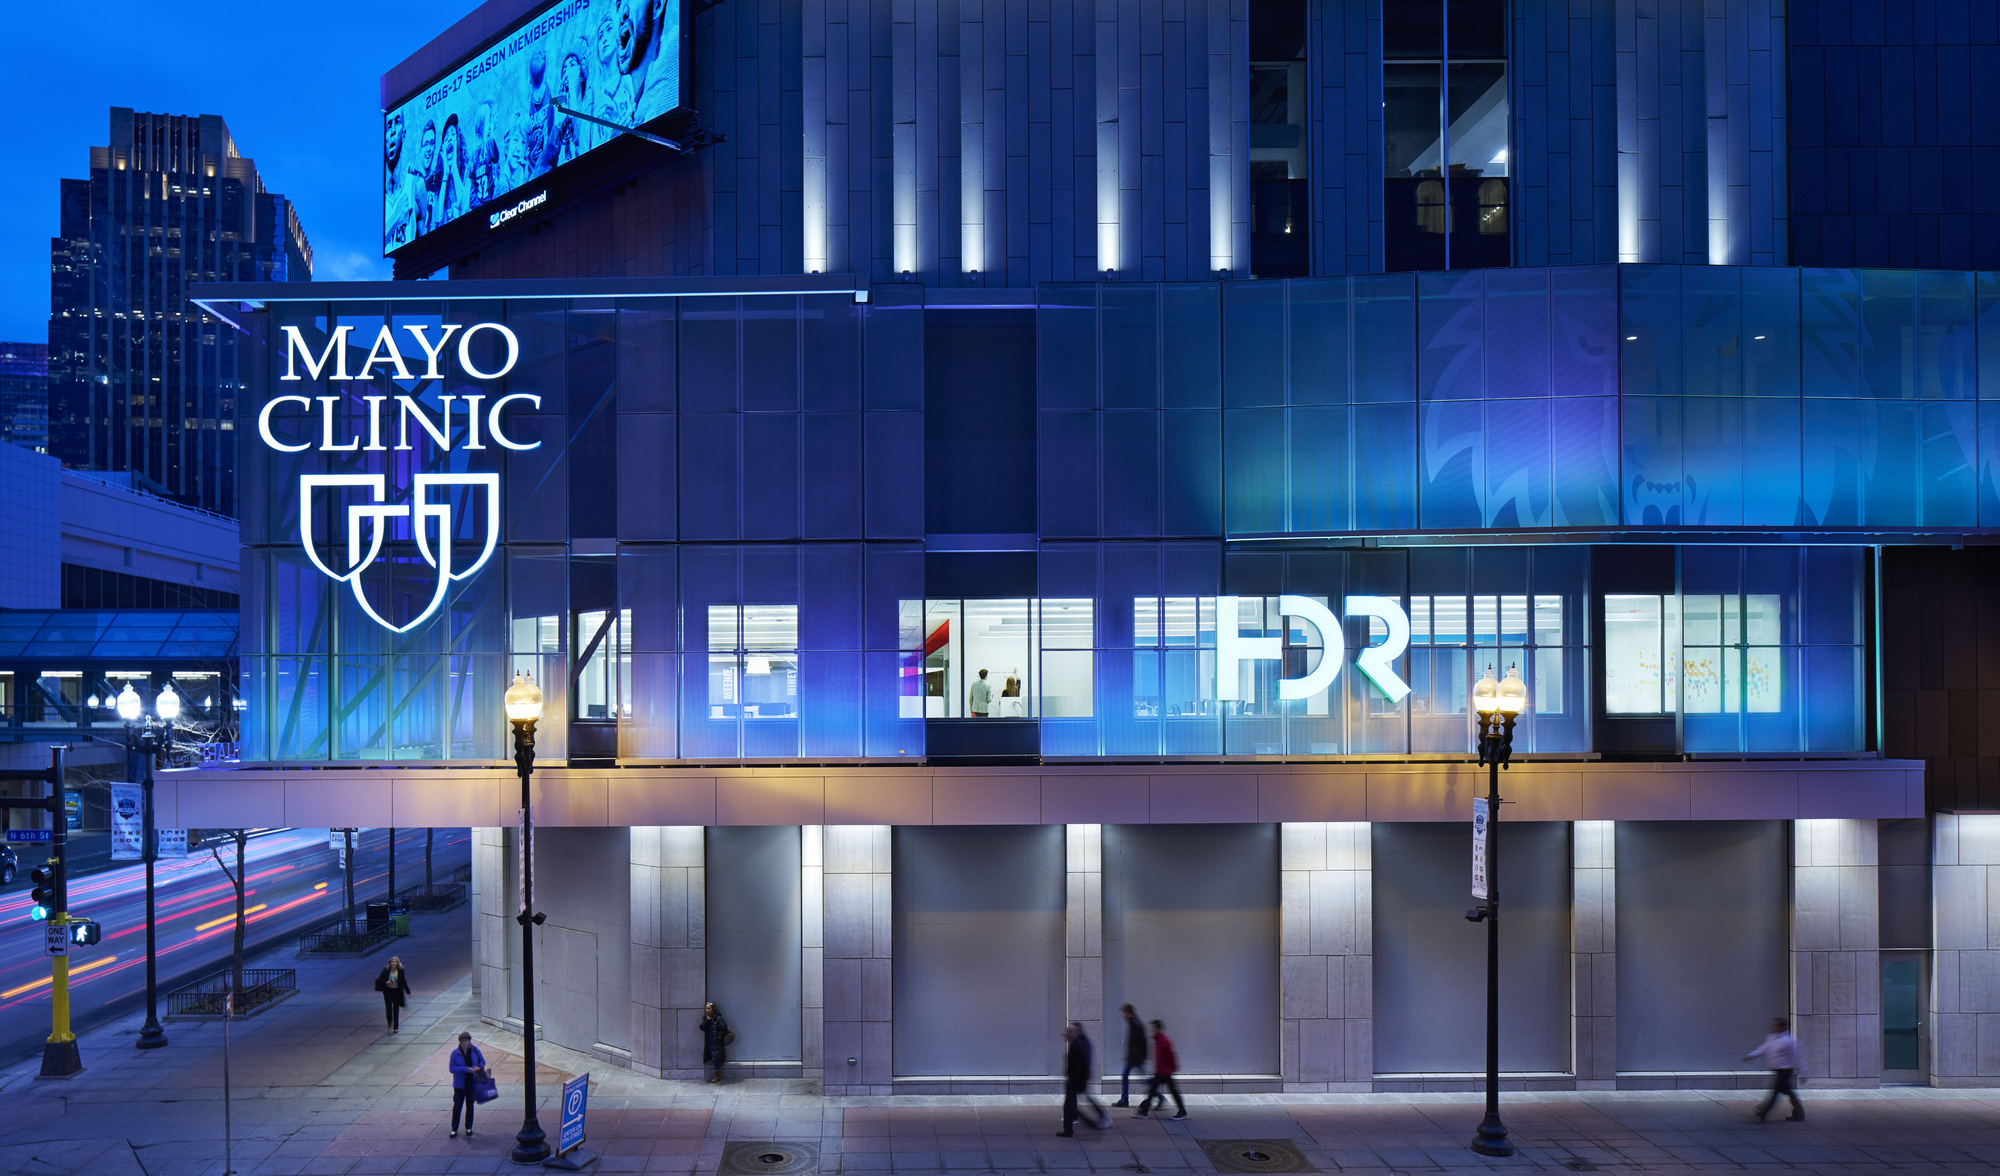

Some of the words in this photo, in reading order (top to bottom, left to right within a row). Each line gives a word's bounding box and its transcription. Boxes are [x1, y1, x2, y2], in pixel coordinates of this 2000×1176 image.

[425, 75, 463, 110] 2016-17
[466, 47, 506, 84] SEASON
[508, 0, 590, 57] MEMBERSHIPS
[500, 209, 517, 222] Clear
[518, 190, 546, 213] Channel
[280, 323, 519, 380] MAYO
[258, 394, 542, 452] CLINIC
[1216, 595, 1412, 703] HDR
[787, 669, 797, 696] MINEY
[47, 936, 64, 944] WAY
[48, 927, 64, 935] ONE
[561, 1136, 570, 1145] 7TH
[570, 1128, 583, 1140] STREET
[563, 1126, 576, 1138] ENTER
[576, 1123, 582, 1131] ON
